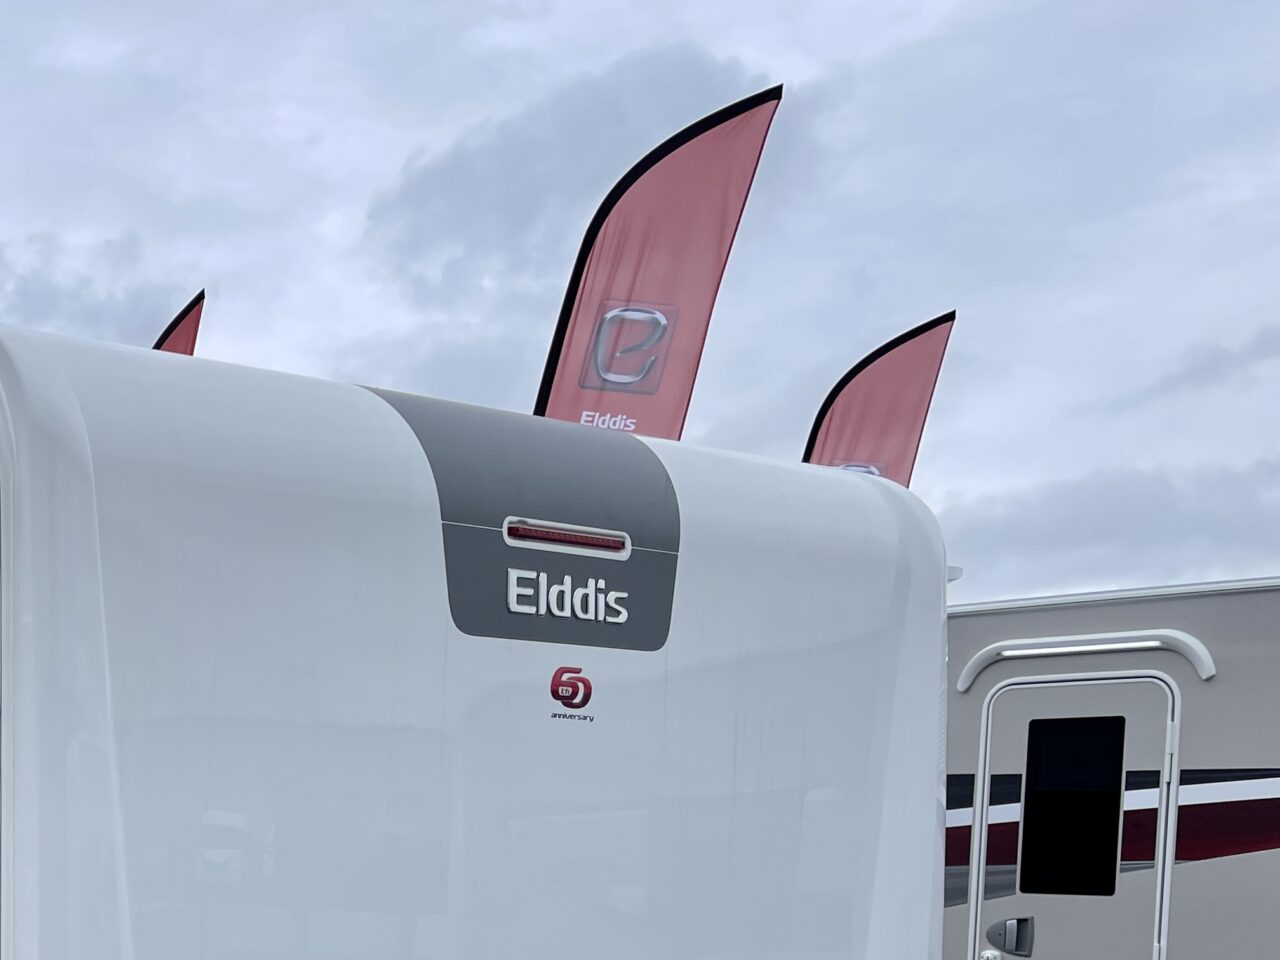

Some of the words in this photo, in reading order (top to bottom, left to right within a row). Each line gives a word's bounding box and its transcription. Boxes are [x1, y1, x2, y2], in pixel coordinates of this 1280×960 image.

[580, 410, 637, 431] Elddis
[507, 567, 629, 624] Elddis
[551, 712, 595, 722] anniversary
